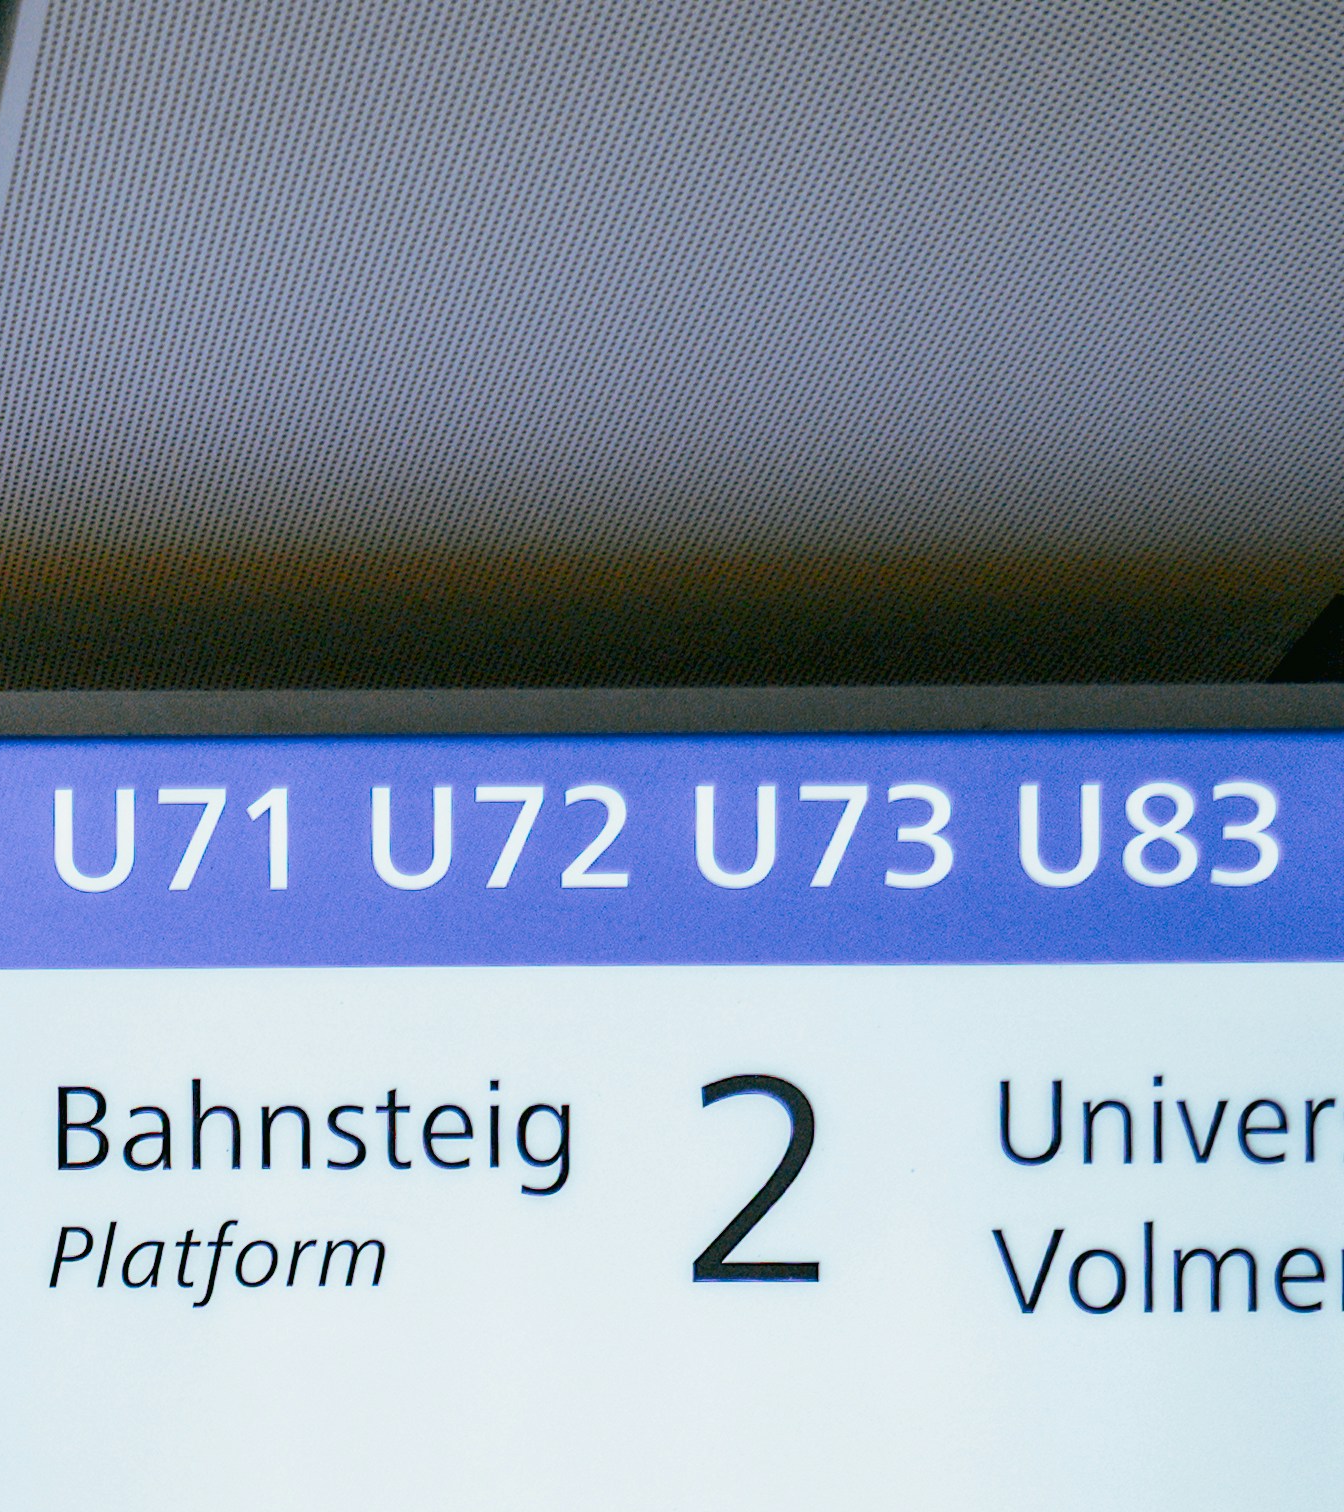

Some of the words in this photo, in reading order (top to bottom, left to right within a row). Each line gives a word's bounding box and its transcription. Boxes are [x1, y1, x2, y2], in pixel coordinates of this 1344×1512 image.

[55, 787, 288, 893] U71
[372, 785, 629, 891] U72
[696, 782, 955, 889] U73
[1019, 780, 1281, 888] U83
[999, 1075, 1344, 1166] Univer
[57, 1078, 570, 1196] Bahnsteig
[692, 1074, 820, 1283] 2
[49, 1219, 386, 1308] Platform
[991, 1220, 1344, 1315] Volme
